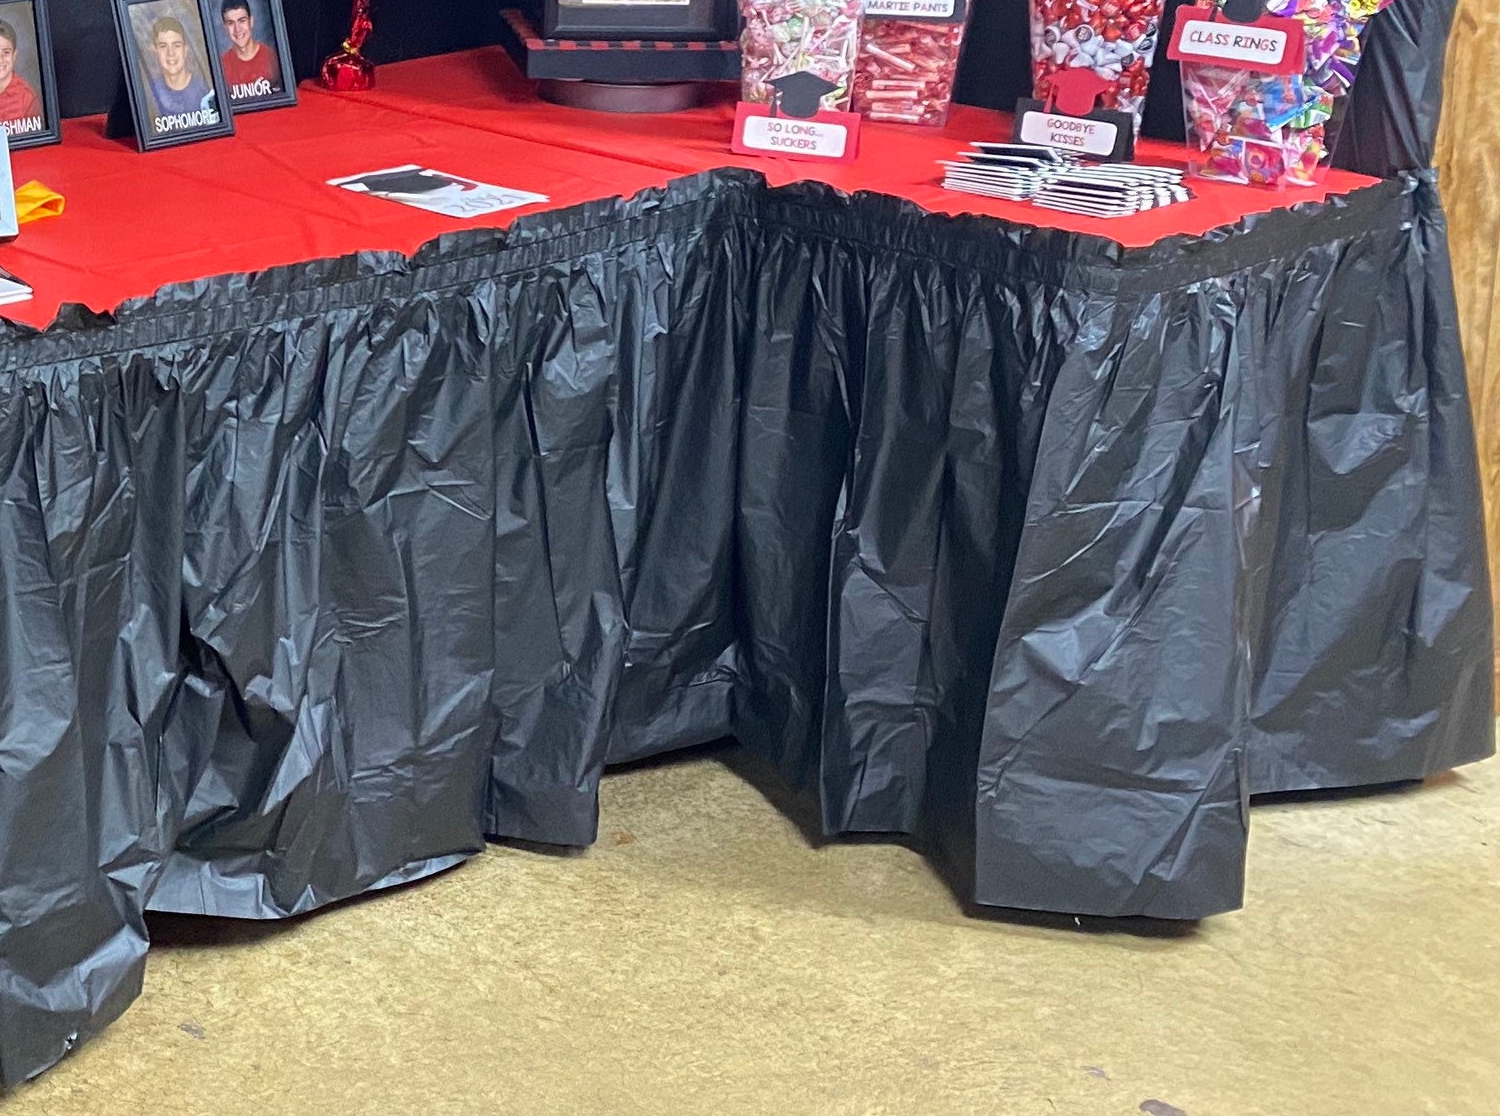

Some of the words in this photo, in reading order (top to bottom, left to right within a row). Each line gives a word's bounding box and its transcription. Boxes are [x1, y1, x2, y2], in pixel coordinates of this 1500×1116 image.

[912, 2, 949, 13] PANTS
[1189, 30, 1230, 46] CLASS
[1232, 35, 1278, 52] RINGS
[230, 80, 272, 100] JUNIOR
[154, 108, 221, 133] SOPHOMORE
[767, 122, 783, 133] SO
[1046, 118, 1096, 135] GOODBYE
[770, 136, 818, 151] SUCKERS
[1050, 132, 1086, 147] KISSES
